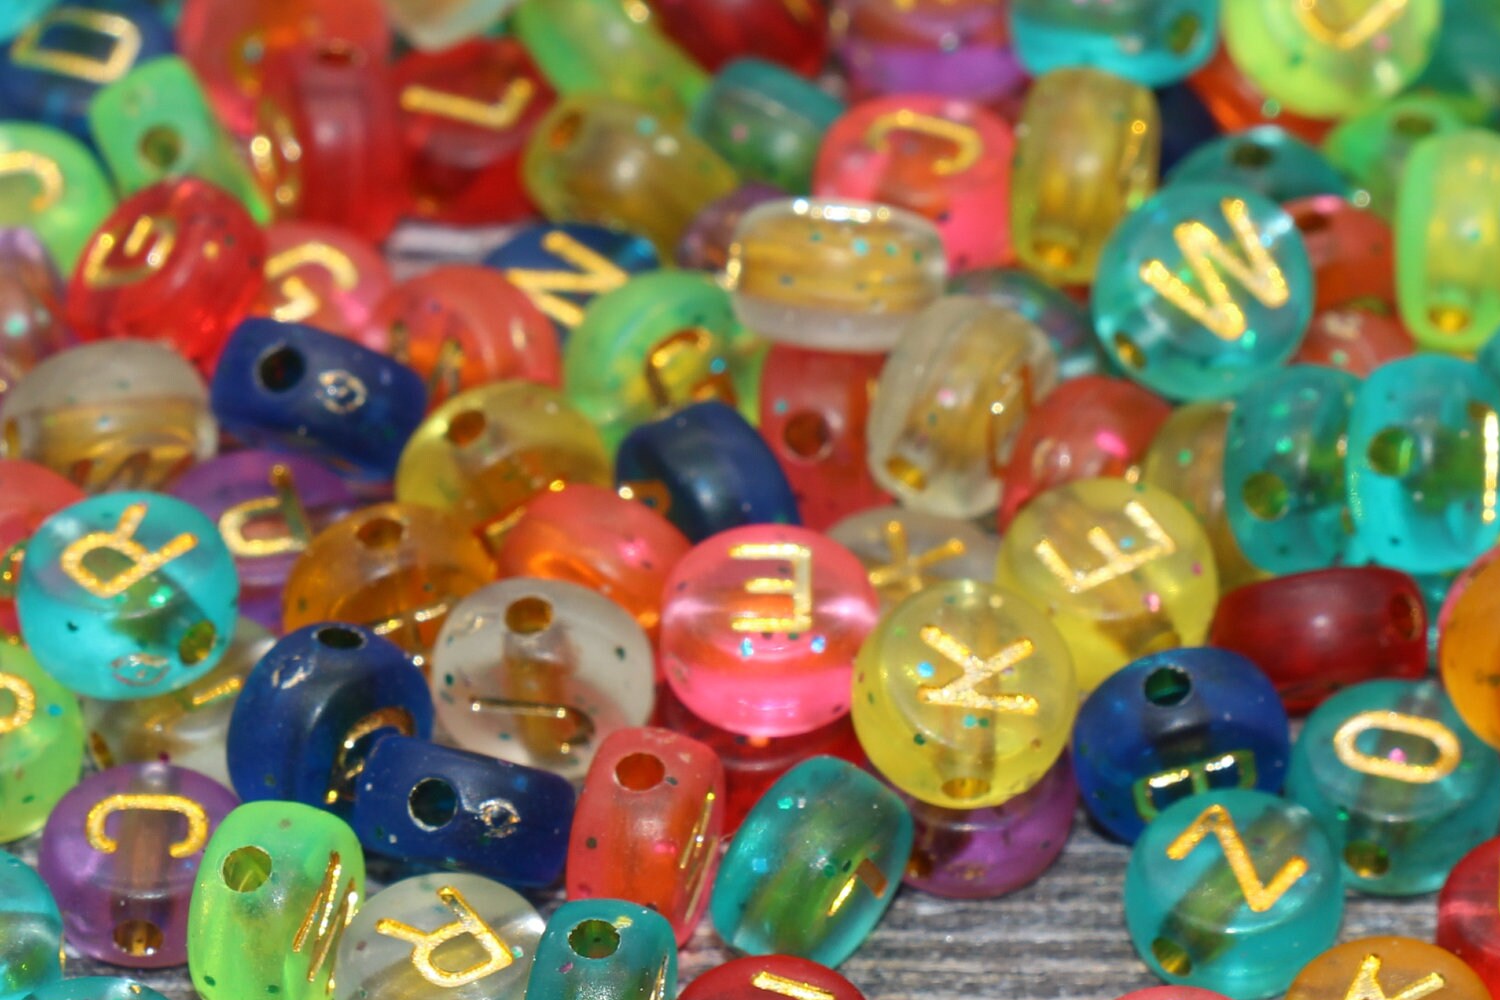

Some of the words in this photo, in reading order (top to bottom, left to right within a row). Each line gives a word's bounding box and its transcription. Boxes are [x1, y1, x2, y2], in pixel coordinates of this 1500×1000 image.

[10, 6, 142, 84] D
[401, 78, 533, 128] L
[1138, 196, 1290, 341] W
[60, 503, 198, 599] R
[729, 542, 813, 632] E
[1035, 499, 1177, 594] E
[917, 624, 1040, 716] K
[1333, 710, 1462, 784] O
[86, 792, 209, 859] C
[375, 885, 514, 988] R
